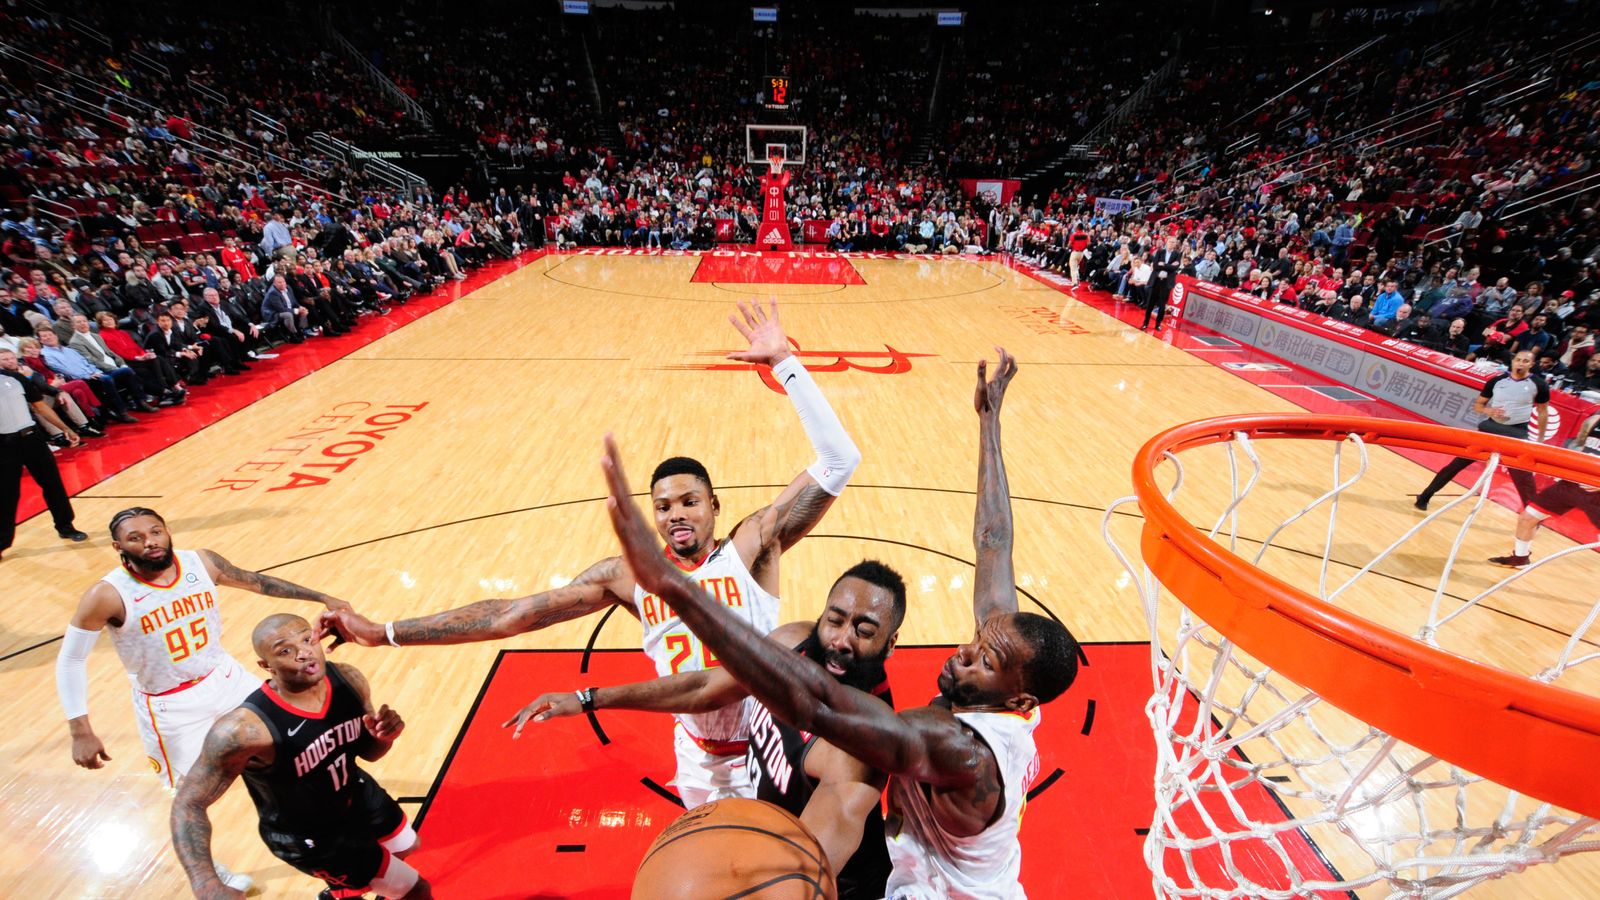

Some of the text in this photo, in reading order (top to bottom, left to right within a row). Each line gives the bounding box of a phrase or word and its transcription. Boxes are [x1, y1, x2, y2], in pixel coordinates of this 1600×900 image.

[771, 78, 789, 88] 5:31
[773, 88, 786, 104] 12
[577, 248, 763, 257] HOUSTON
[200, 401, 372, 493] CENTER
[264, 401, 430, 493] TOYOTA
[140, 591, 214, 634] ATLANTA
[164, 616, 209, 663] 95
[294, 716, 361, 778] HOUSTON
[750, 699, 793, 795] USTON
[327, 752, 349, 792] 17
